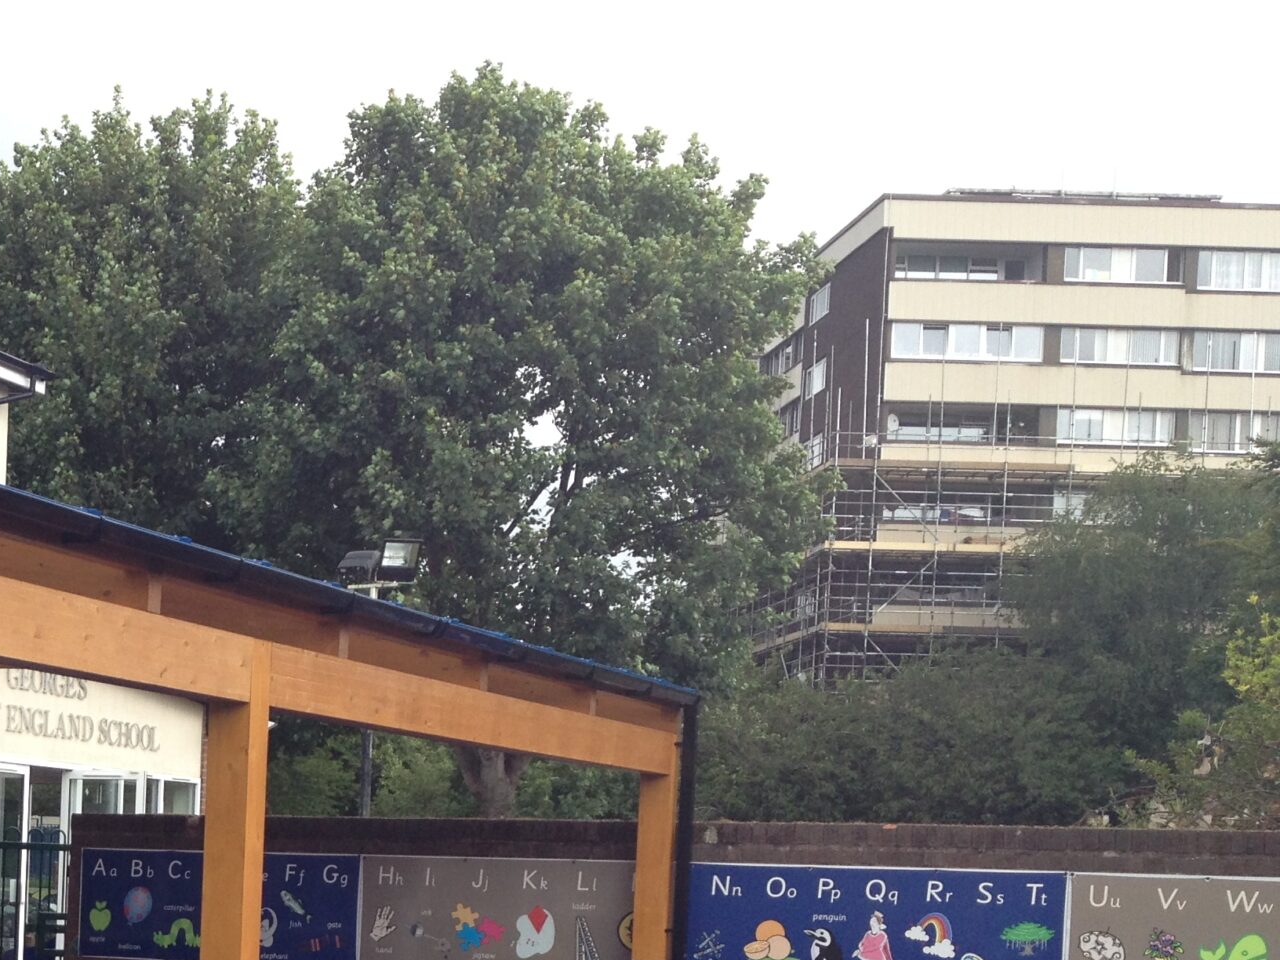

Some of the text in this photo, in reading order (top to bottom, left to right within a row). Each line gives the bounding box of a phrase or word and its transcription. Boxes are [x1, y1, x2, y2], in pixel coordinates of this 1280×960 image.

[6, 668, 88, 701] GEORGES
[5, 704, 94, 742] ENGLAND
[97, 717, 161, 753] SCHOOL
[711, 875, 1048, 906] Nn Oo Pp Qq Rr Ss Tt
[1089, 885, 1274, 913] Uu Vv Ww
[289, 920, 302, 928] fish
[812, 913, 847, 923] penguin
